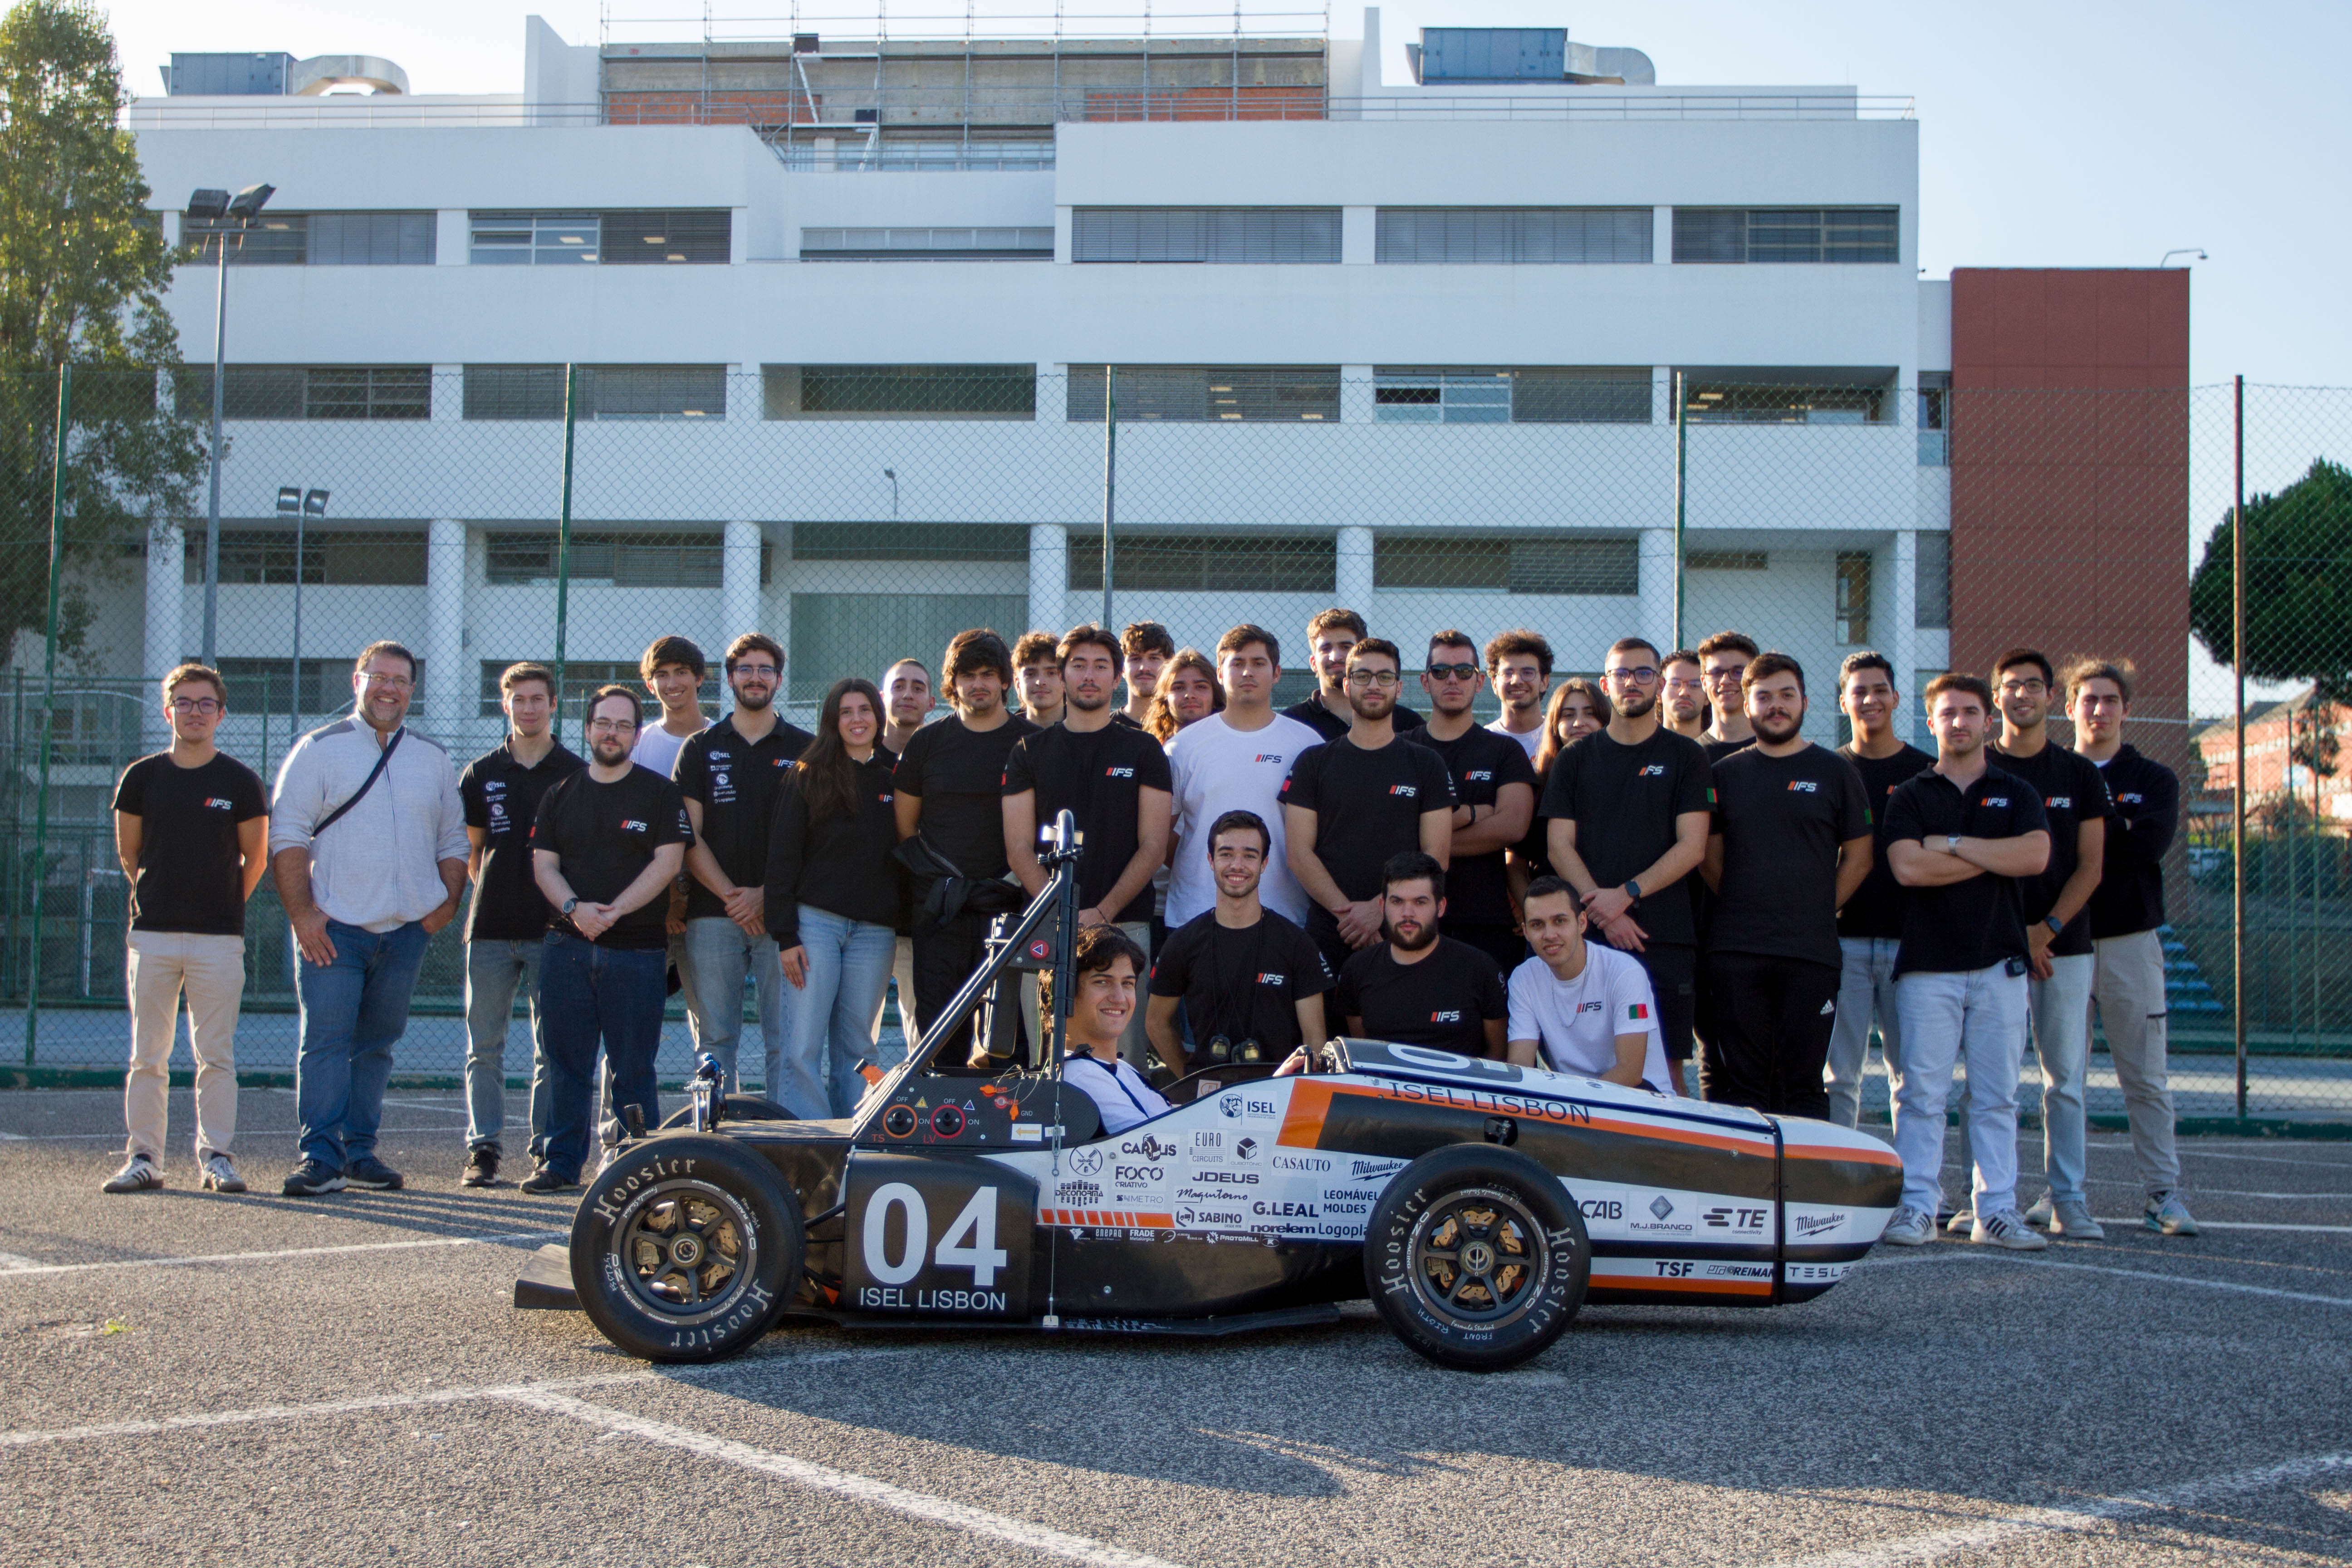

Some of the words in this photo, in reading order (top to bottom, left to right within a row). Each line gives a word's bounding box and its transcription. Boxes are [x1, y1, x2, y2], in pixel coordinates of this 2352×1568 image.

[1260, 754, 1282, 764] IFS
[1112, 767, 1134, 778] IFS
[1470, 771, 1492, 780] IFS
[1395, 785, 1416, 797] IFS
[1793, 781, 1817, 792] IFS
[211, 798, 232, 811] IFS
[883, 794, 893, 802] IF
[1986, 797, 2008, 807] IFS
[2050, 797, 2071, 808] IFS
[2122, 793, 2142, 804] IFS
[626, 820, 647, 833] IFS
[1261, 973, 1284, 985] IFS
[1581, 1001, 1602, 1013] IFS
[1436, 1010, 1460, 1022] IFS
[1247, 1101, 1276, 1114] ISEL
[1389, 1082, 1465, 1106] ISEL
[1471, 1092, 1590, 1124] LISBON
[872, 1134, 885, 1143] TS
[923, 1134, 937, 1144] LV
[1196, 1132, 1221, 1147] EURO
[1272, 1156, 1331, 1172] CASAUTO
[1350, 1160, 1404, 1176] Milwaukee
[1115, 1166, 1164, 1181] FOCO
[1192, 1171, 1259, 1185] JDEUS
[593, 1154, 696, 1226] Hoosier
[1324, 1188, 1379, 1201] LEOMÁVEL
[726, 1194, 748, 1220] RACING
[1253, 1201, 1319, 1218] G.LEAL
[1323, 1203, 1367, 1214] MOLDES
[1574, 1200, 1622, 1220] CAB
[1198, 1212, 1242, 1224] SABINO
[1736, 1208, 1768, 1228] TE
[1793, 1212, 1845, 1232] Milwaukee
[1129, 1229, 1155, 1237] FRADE
[1250, 1223, 1315, 1234] norelem
[1630, 1223, 1692, 1231] M.J.BRANCO
[863, 1182, 1007, 1287] 04
[1380, 1188, 1426, 1295] Hoosier
[1655, 1261, 1694, 1277] TSF
[1529, 1226, 1576, 1333] Hoosier
[620, 1284, 643, 1310] RACING
[860, 1287, 911, 1308] ISEL
[918, 1289, 1006, 1311] LISBON
[670, 1278, 773, 1352] Hoosier
[1451, 1320, 1473, 1331] Formula
